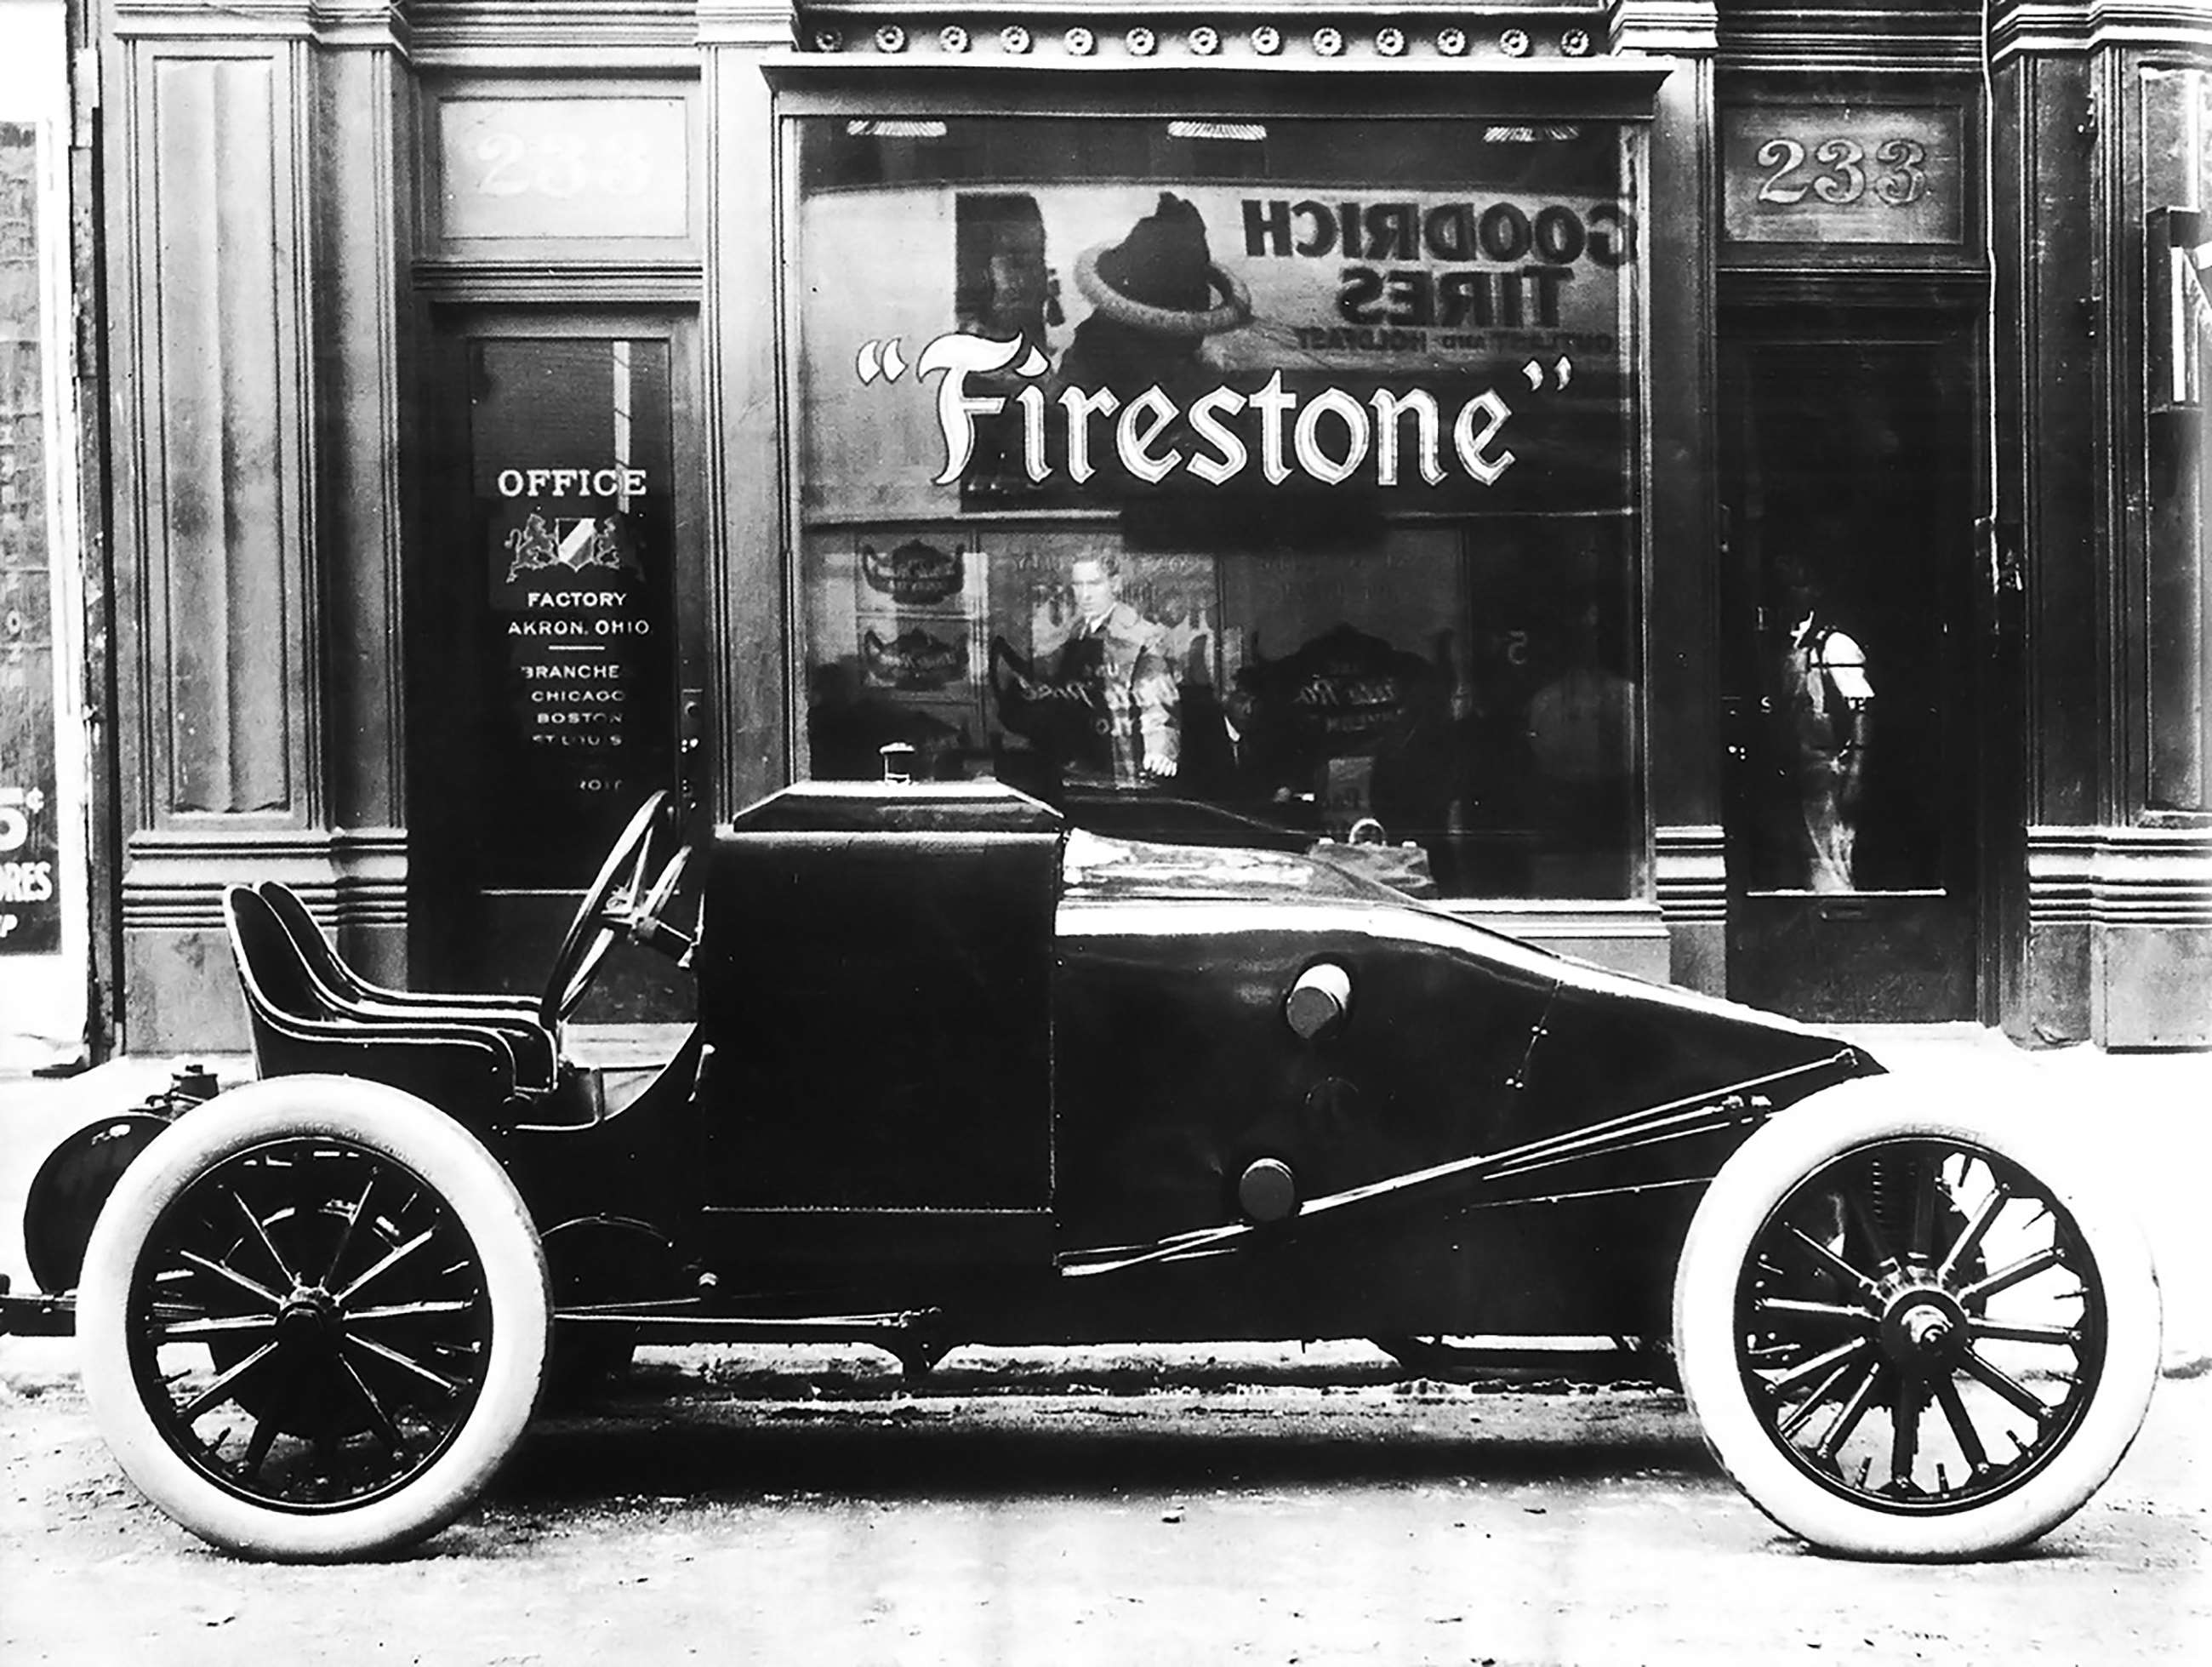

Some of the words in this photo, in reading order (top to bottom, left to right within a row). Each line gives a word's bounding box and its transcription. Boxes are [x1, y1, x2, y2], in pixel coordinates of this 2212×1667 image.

[1757, 138, 1927, 206] 233
[498, 469, 647, 496] OFFICE
[527, 592, 626, 607] FACTORY
[596, 619, 649, 635] OHIO
[532, 690, 625, 702] CHICAGO
[538, 712, 623, 724] BOSTON
